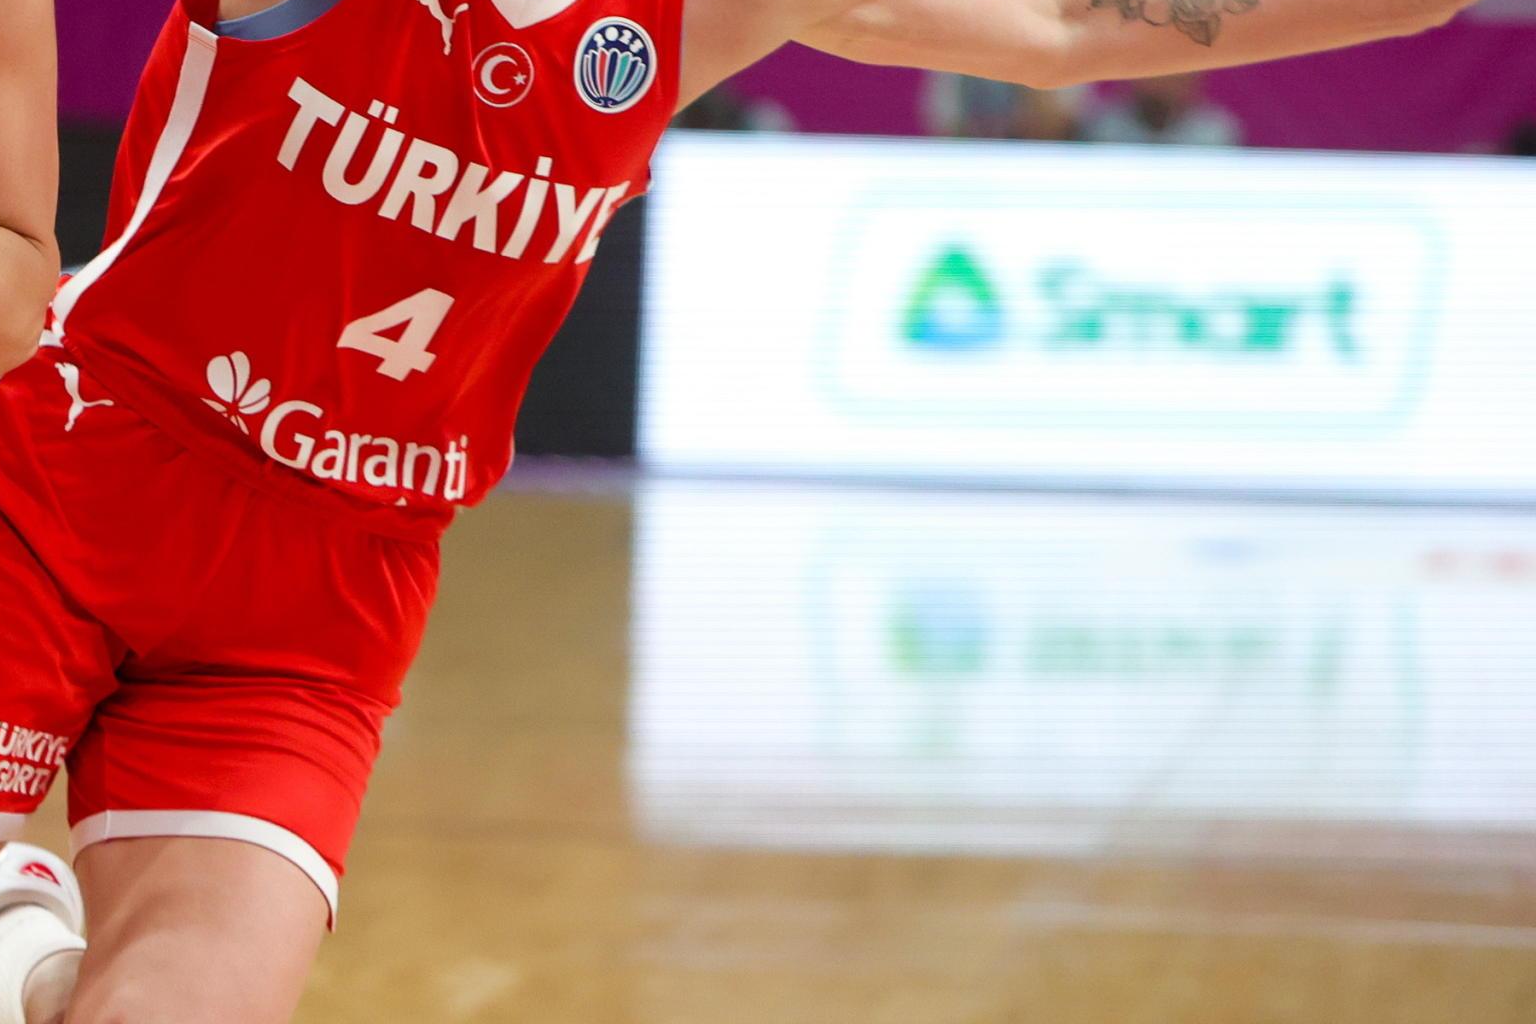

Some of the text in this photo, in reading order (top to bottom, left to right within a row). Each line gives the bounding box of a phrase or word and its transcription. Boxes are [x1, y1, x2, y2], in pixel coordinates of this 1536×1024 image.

[593, 26, 644, 54] 2025
[336, 287, 456, 382] 4
[259, 399, 469, 502] Garanti
